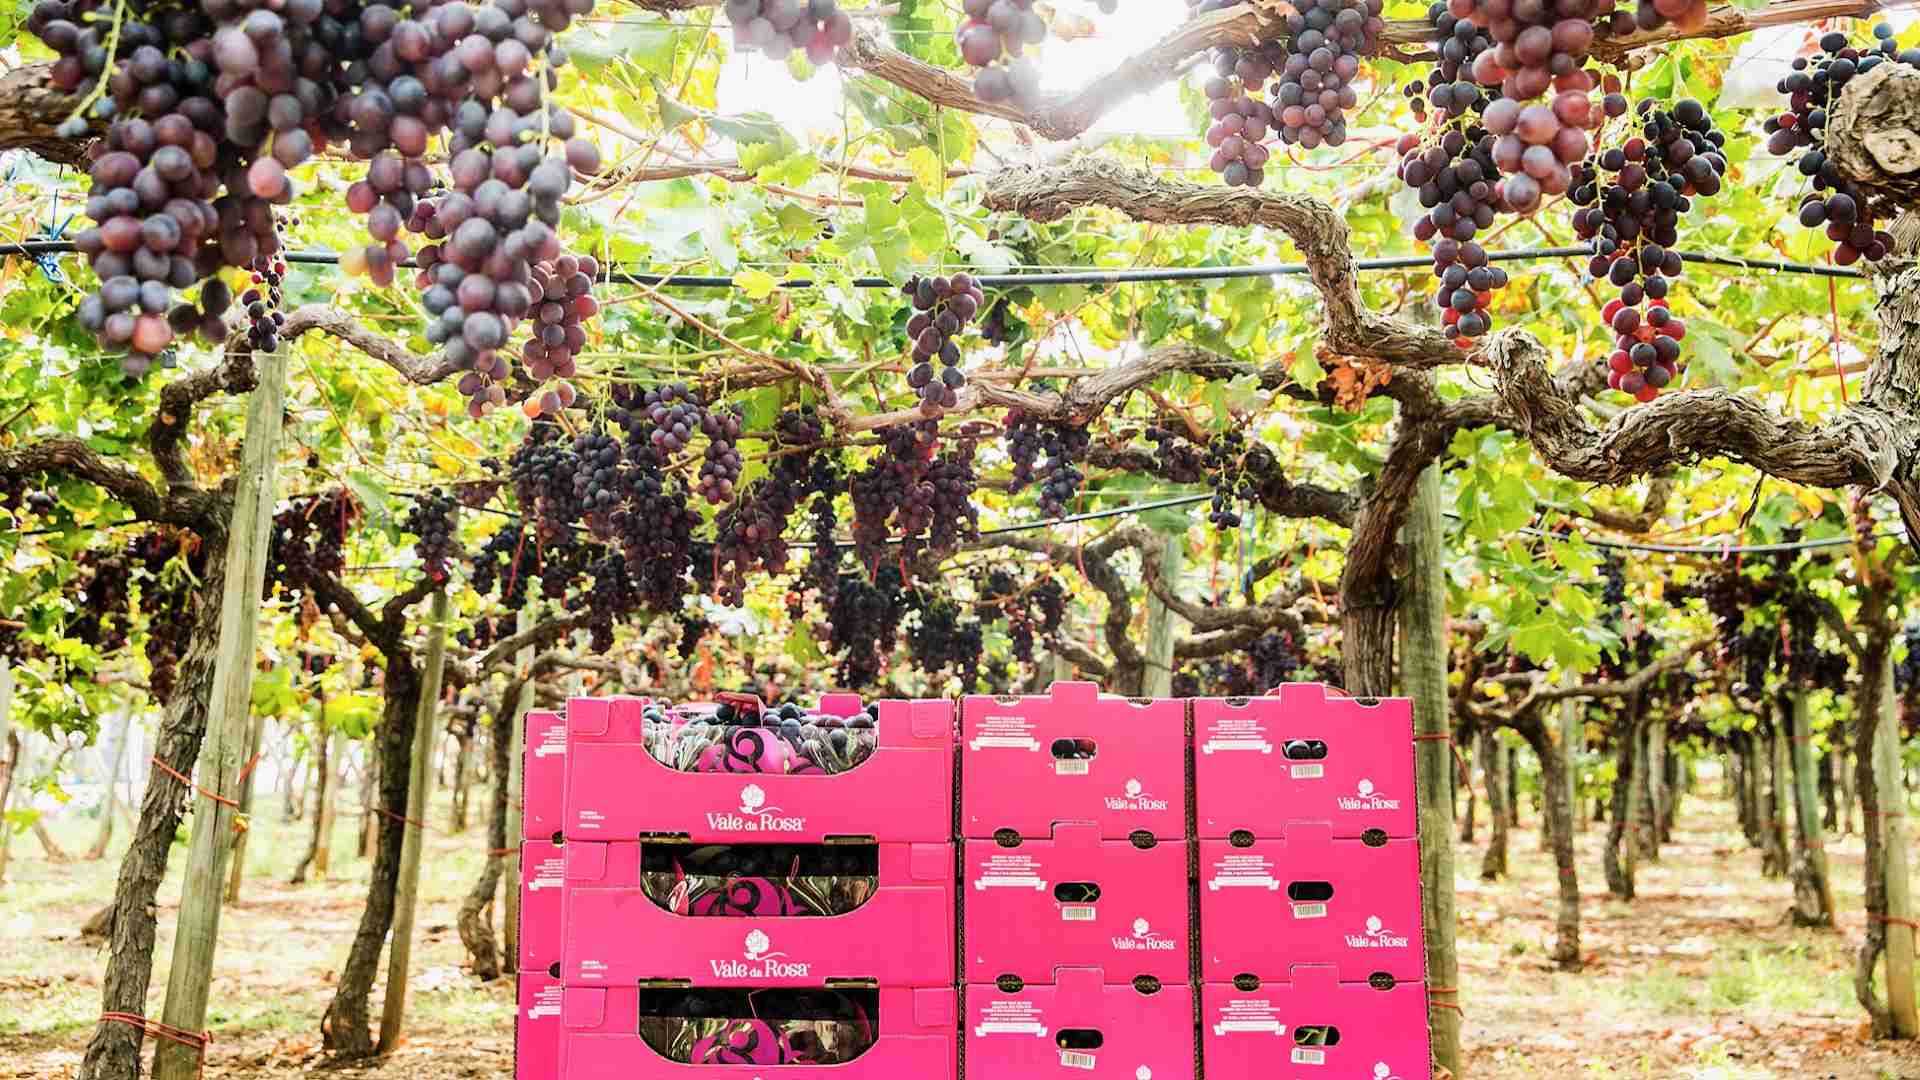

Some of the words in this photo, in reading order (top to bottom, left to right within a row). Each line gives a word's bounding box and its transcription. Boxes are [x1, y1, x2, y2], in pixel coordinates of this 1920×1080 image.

[705, 813, 743, 831] Vale
[744, 820, 758, 831] da
[760, 813, 803, 831] Rosa
[1147, 937, 1176, 950] Rosa
[1380, 935, 1408, 947] Rosa
[710, 959, 747, 978] Vale
[749, 967, 762, 977] da
[765, 959, 808, 977] Rosa
